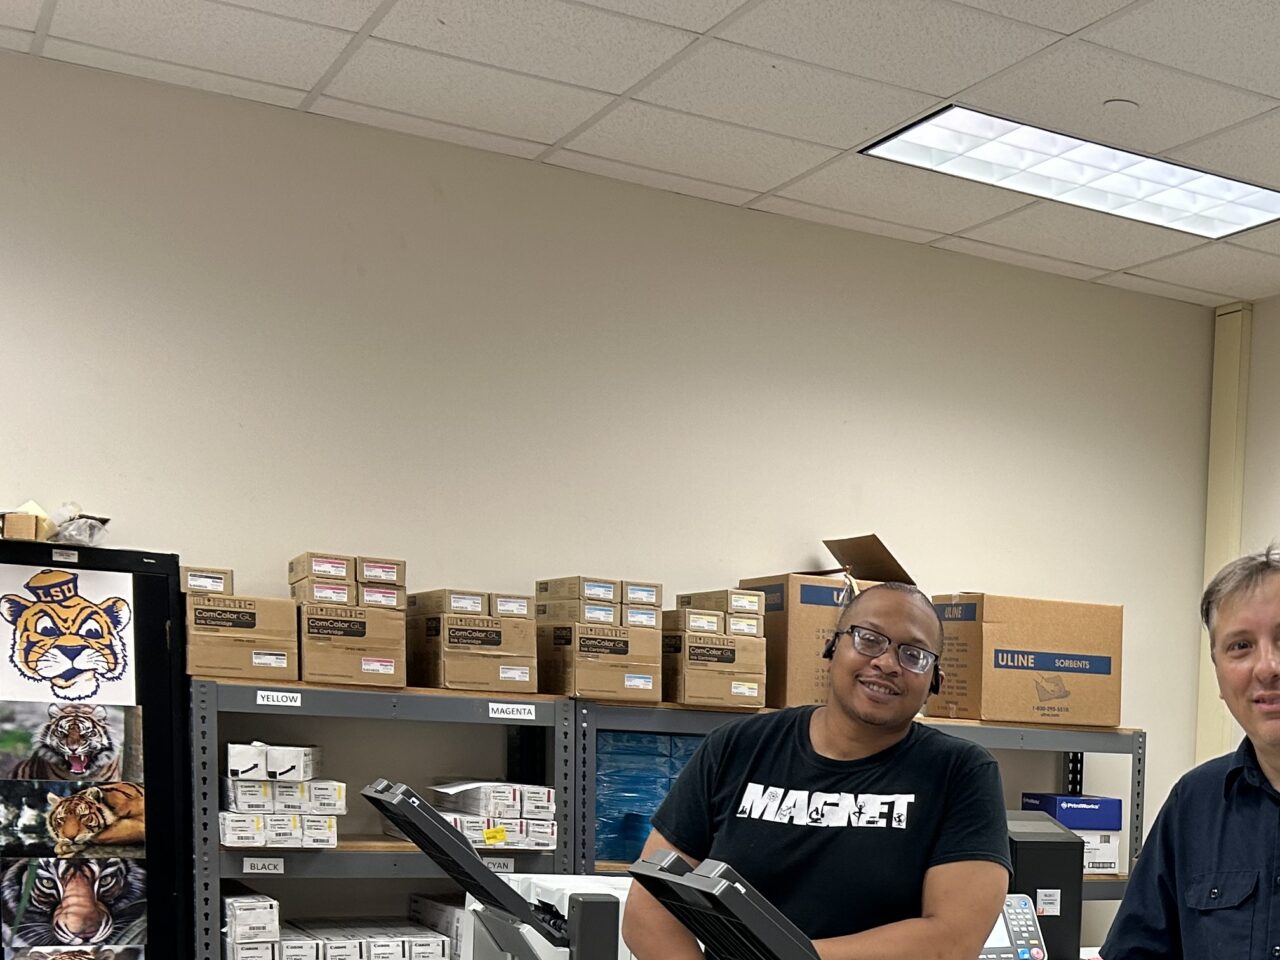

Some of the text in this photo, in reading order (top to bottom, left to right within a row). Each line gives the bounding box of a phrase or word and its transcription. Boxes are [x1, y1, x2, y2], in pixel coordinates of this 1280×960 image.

[36, 583, 75, 601] LSU
[195, 609, 252, 620] ComColor GL
[309, 620, 349, 629] ComColor
[449, 629, 486, 638] ComColor
[580, 638, 614, 647] ComColor
[690, 647, 722, 655] ComColor
[998, 652, 1090, 669] ULINE SORBENTS
[260, 694, 299, 703] YELLOW
[491, 706, 533, 716] MAGENTA
[736, 782, 915, 829] MAGNET
[250, 861, 280, 871] BLACK
[487, 862, 509, 870] CYAN
